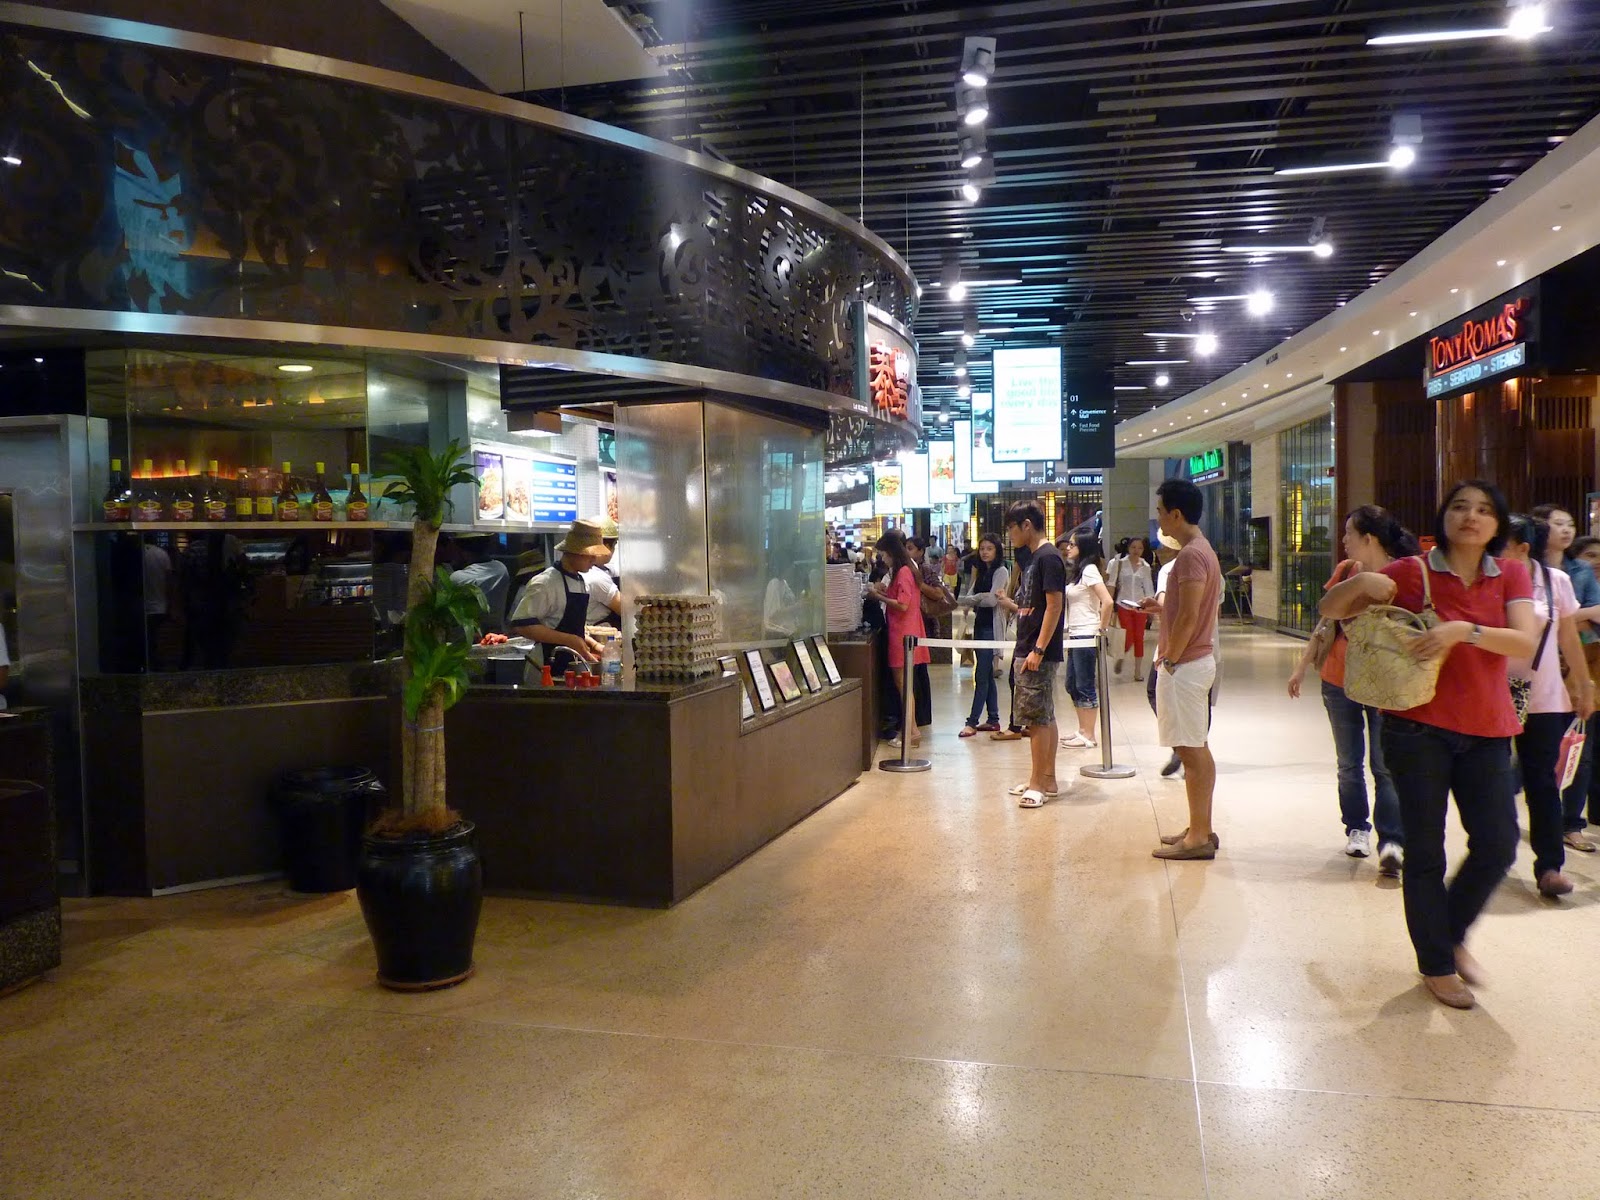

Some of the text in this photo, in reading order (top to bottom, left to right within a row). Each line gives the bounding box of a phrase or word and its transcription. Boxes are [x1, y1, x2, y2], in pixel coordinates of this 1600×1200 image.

[1430, 333, 1463, 370] TONY
[1449, 364, 1482, 386] SEAFOOD
[1490, 348, 1521, 372] STEAKS
[1030, 476, 1066, 484] RESTAN
[1070, 475, 1092, 484] CRYSTAL
